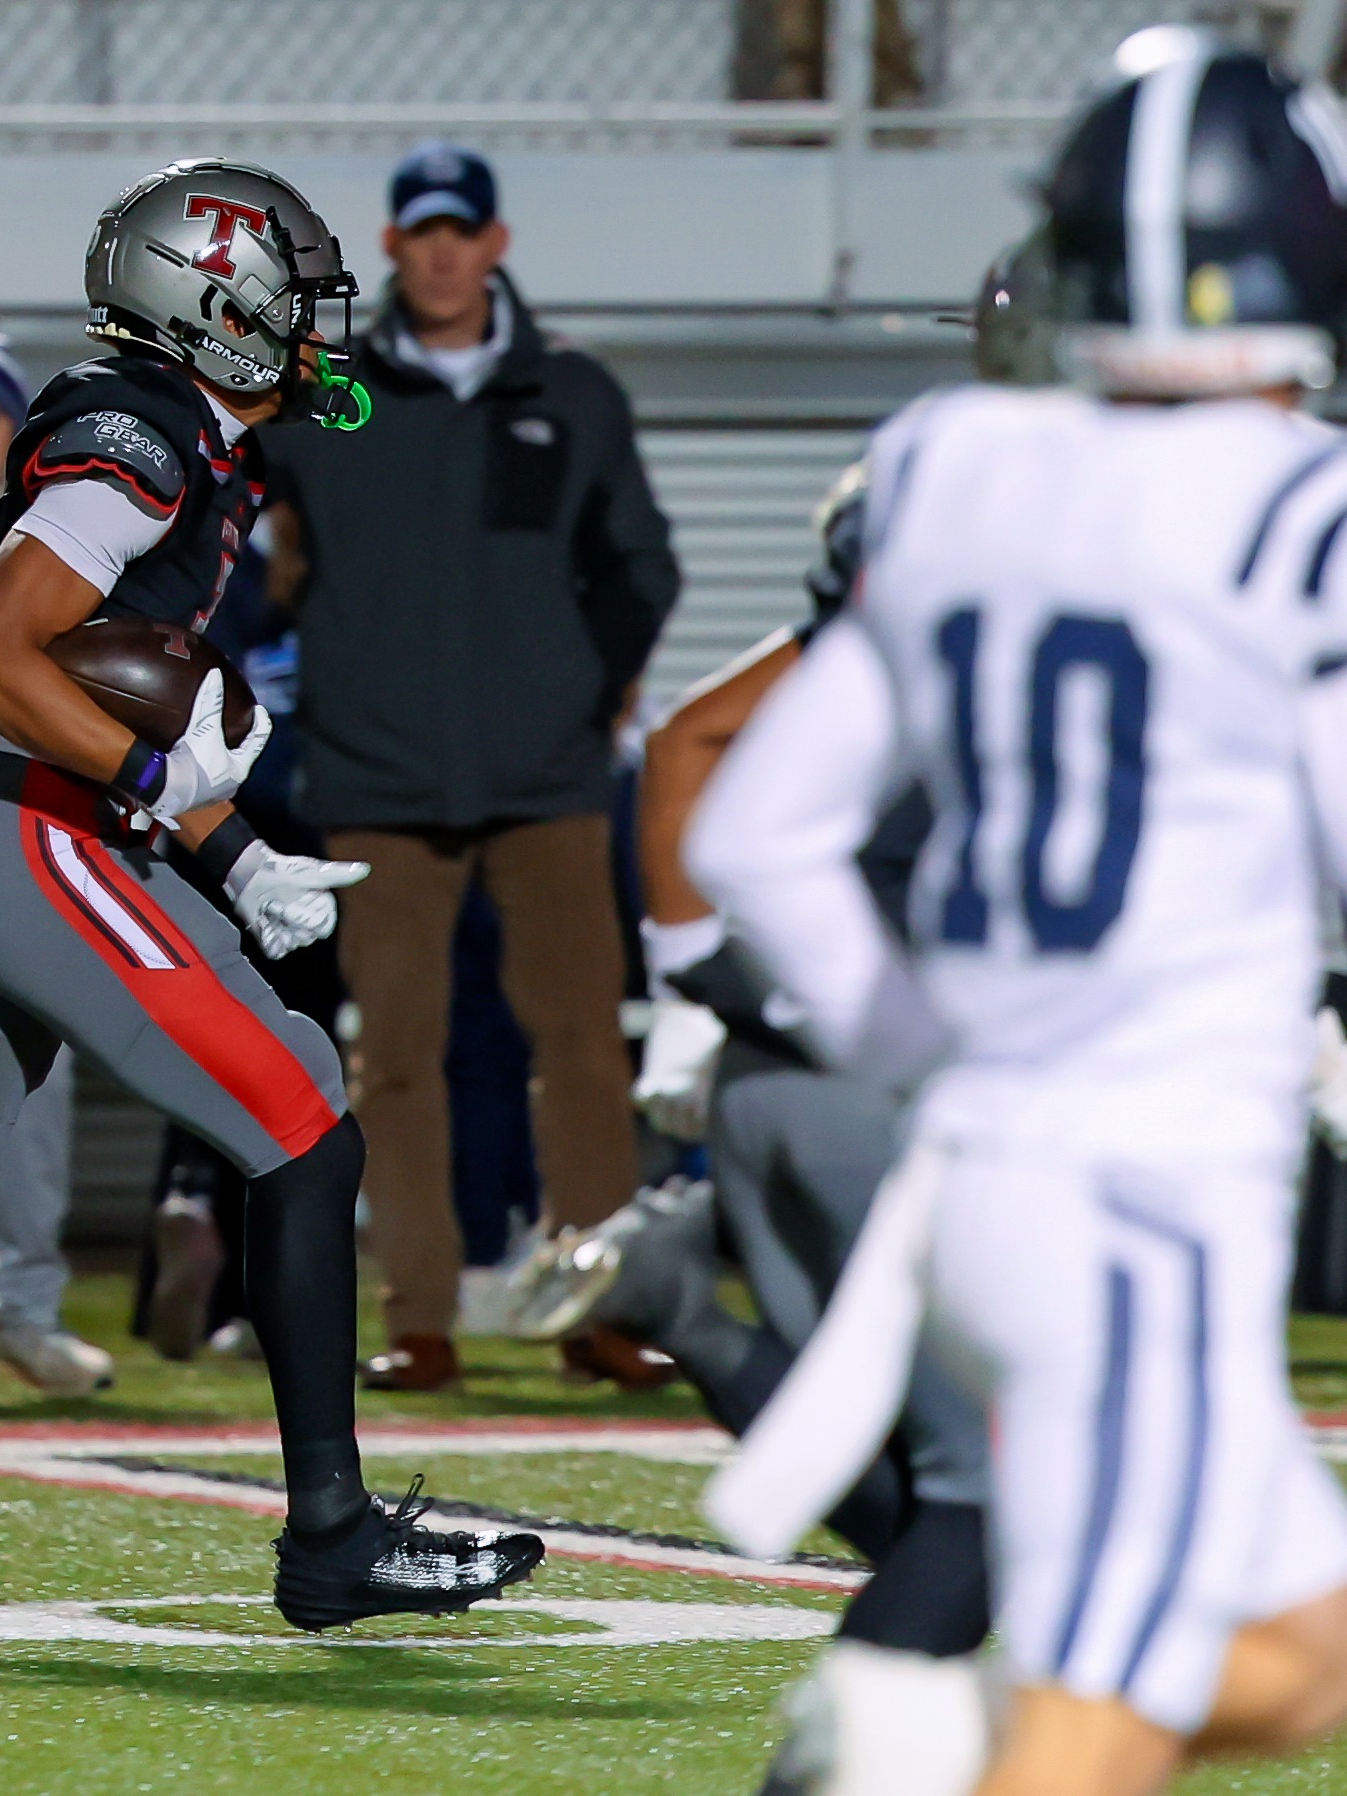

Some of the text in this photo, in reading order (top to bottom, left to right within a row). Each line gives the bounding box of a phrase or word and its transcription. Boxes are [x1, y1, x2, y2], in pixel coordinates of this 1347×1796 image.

[184, 193, 269, 280] T
[201, 336, 281, 384] ARMOUR
[77, 410, 139, 429] PRO
[94, 422, 167, 470] GEAR
[937, 607, 1150, 953] 10
